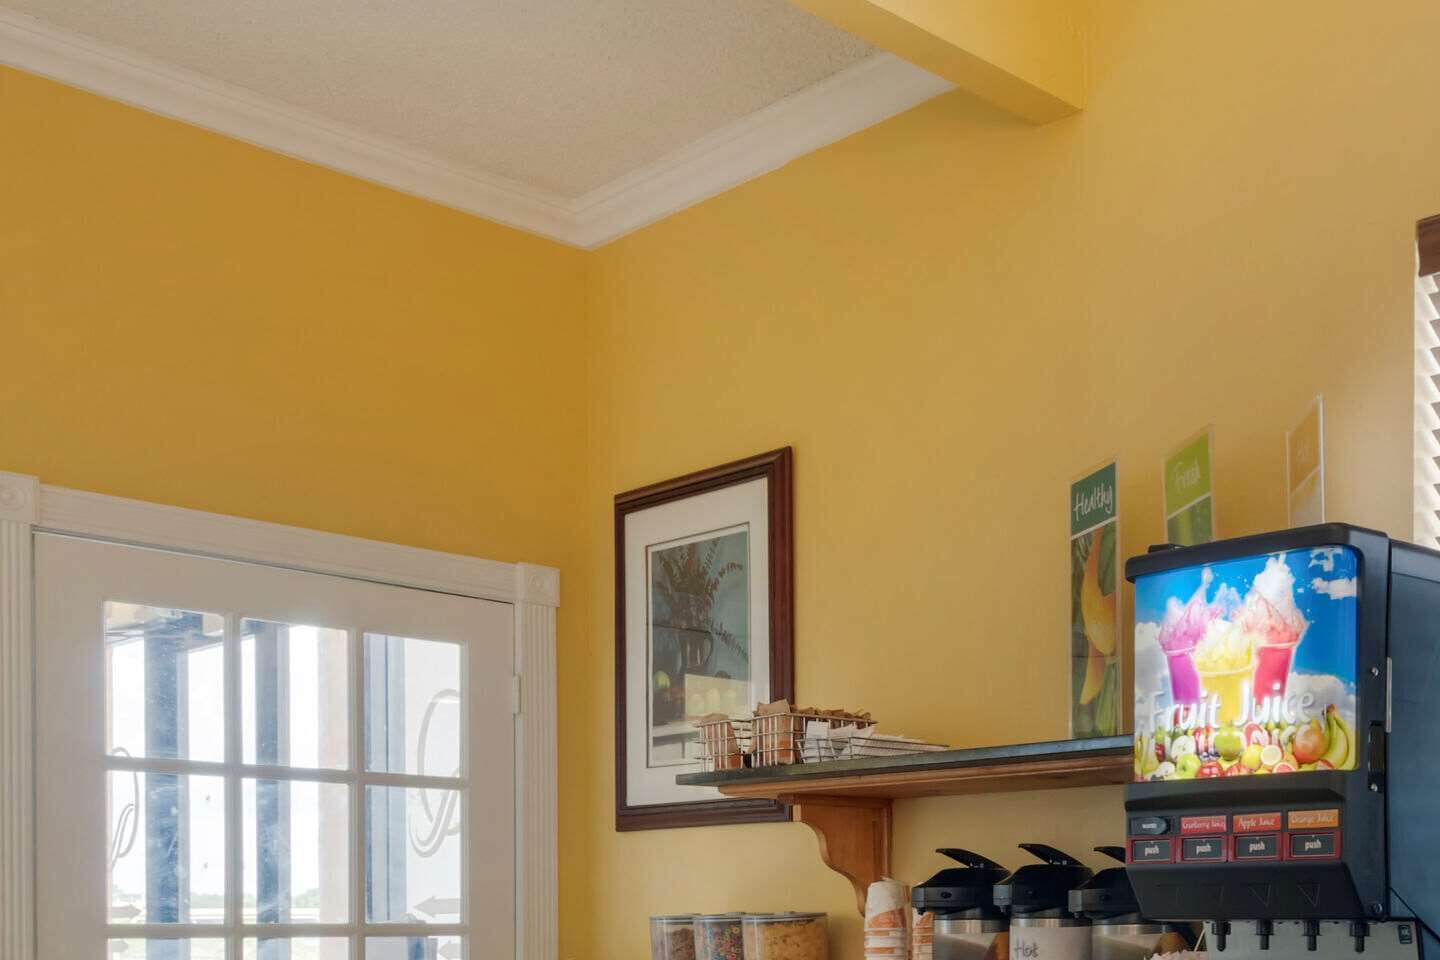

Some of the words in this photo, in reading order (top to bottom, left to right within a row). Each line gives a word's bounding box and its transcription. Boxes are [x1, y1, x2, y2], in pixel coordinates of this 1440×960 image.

[1073, 483, 1113, 521] Healthy
[1152, 689, 1222, 732] Fruit
[1233, 680, 1315, 729] Juice
[1238, 816, 1257, 829] Apple
[1259, 816, 1275, 826] Juice
[1144, 844, 1160, 856] push
[1196, 843, 1212, 855] push
[1249, 841, 1265, 853] push
[1305, 839, 1322, 851] push
[1014, 938, 1039, 958] Hot
